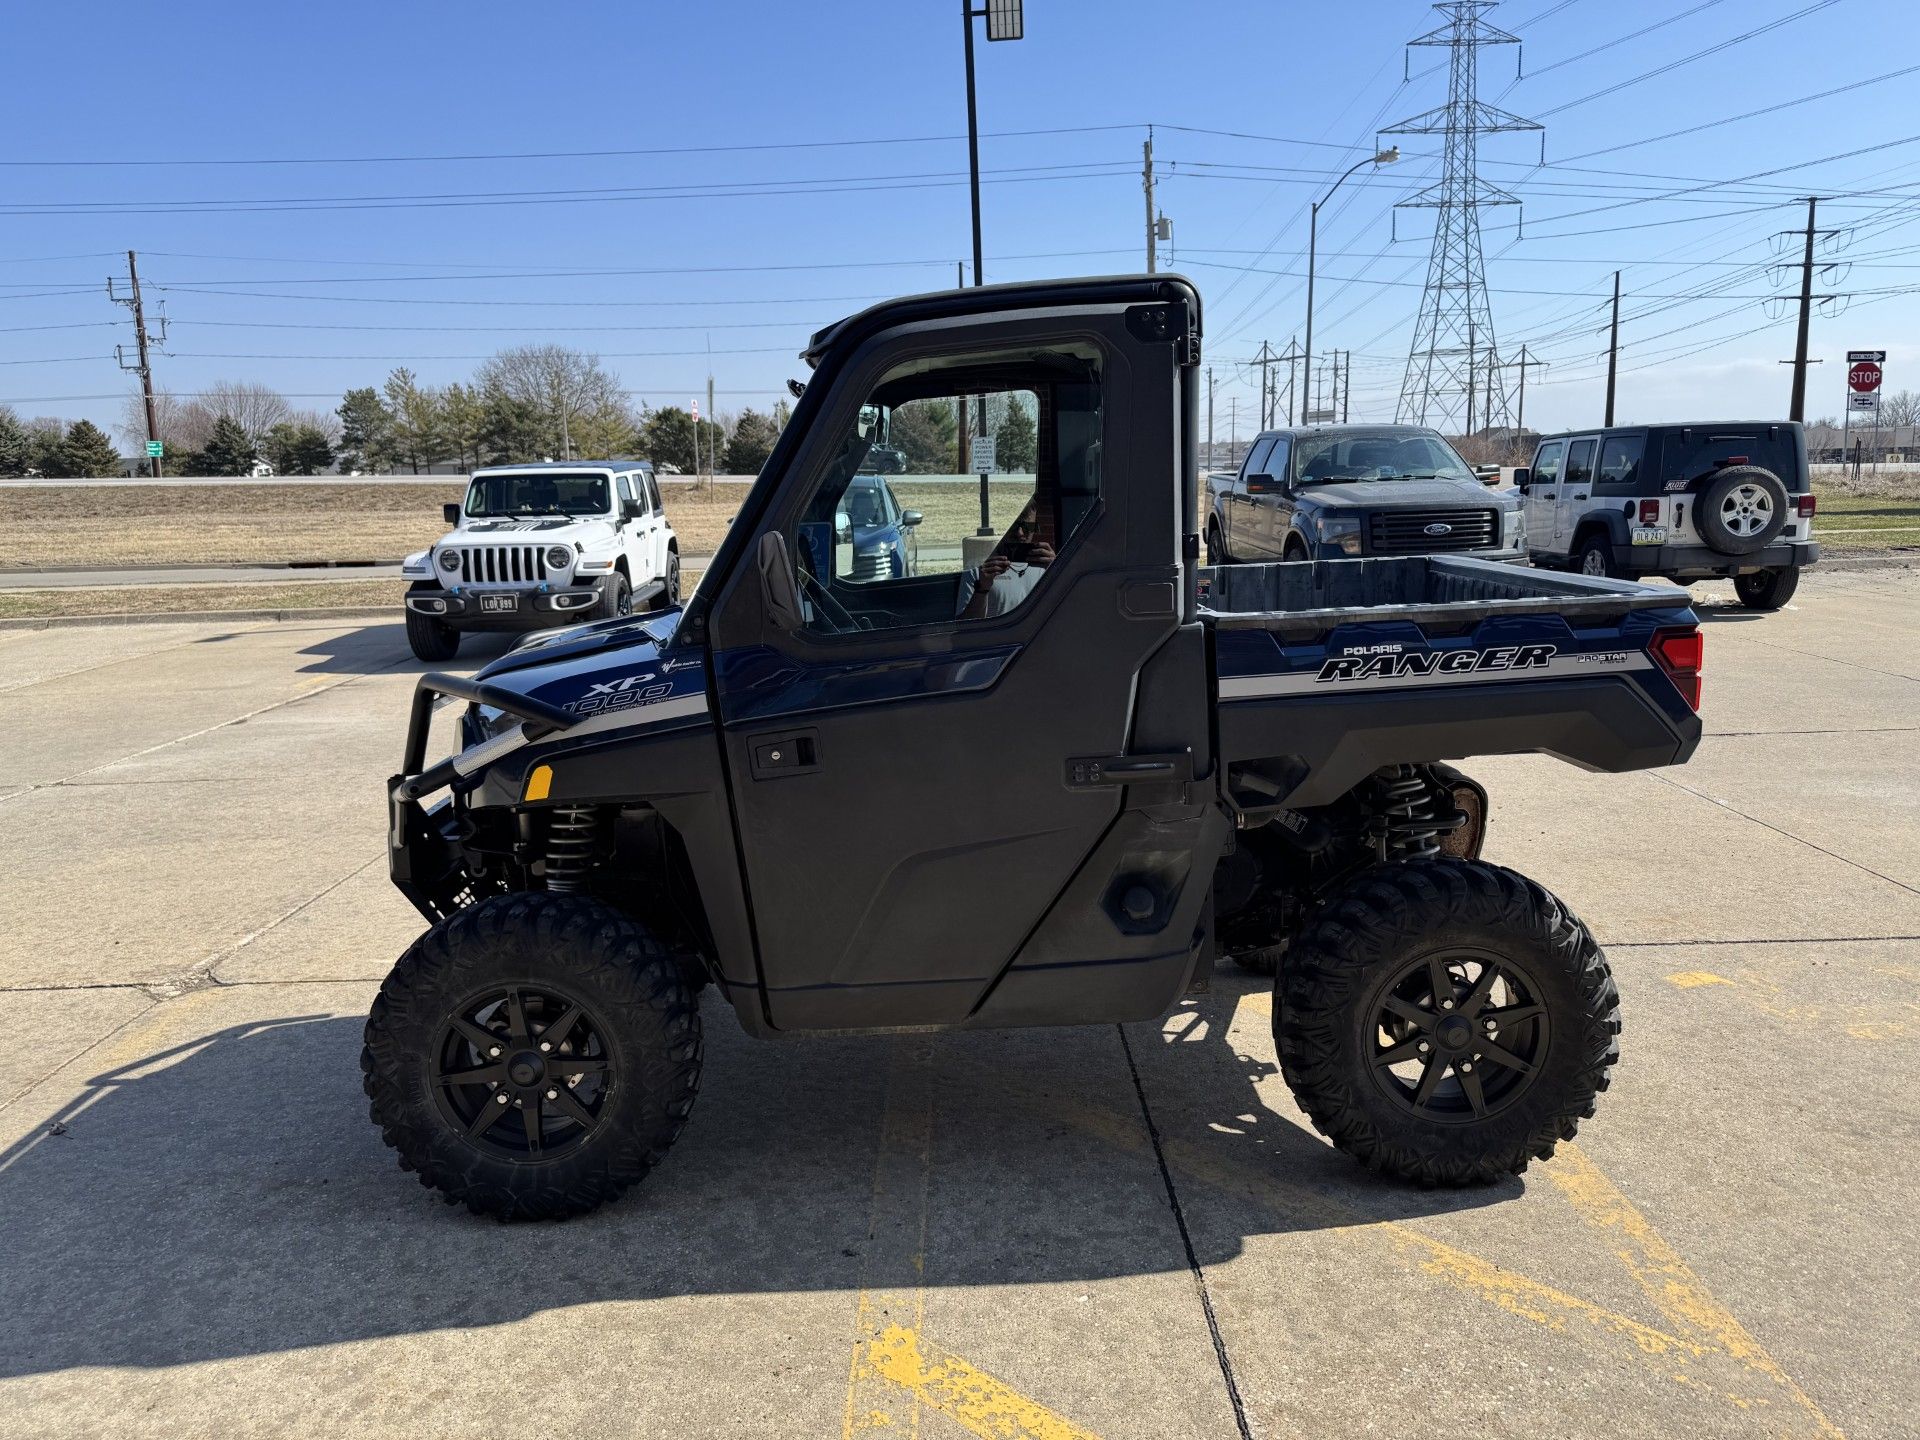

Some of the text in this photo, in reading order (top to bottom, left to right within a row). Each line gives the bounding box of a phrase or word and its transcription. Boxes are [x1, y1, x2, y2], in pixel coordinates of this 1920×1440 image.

[1850, 371, 1880, 383] STOP
[1344, 644, 1402, 656] POLARIS
[1577, 653, 1627, 662] PROSTAR
[1315, 645, 1557, 682] RANGER
[581, 673, 656, 698] XP
[562, 682, 673, 713] 1000
